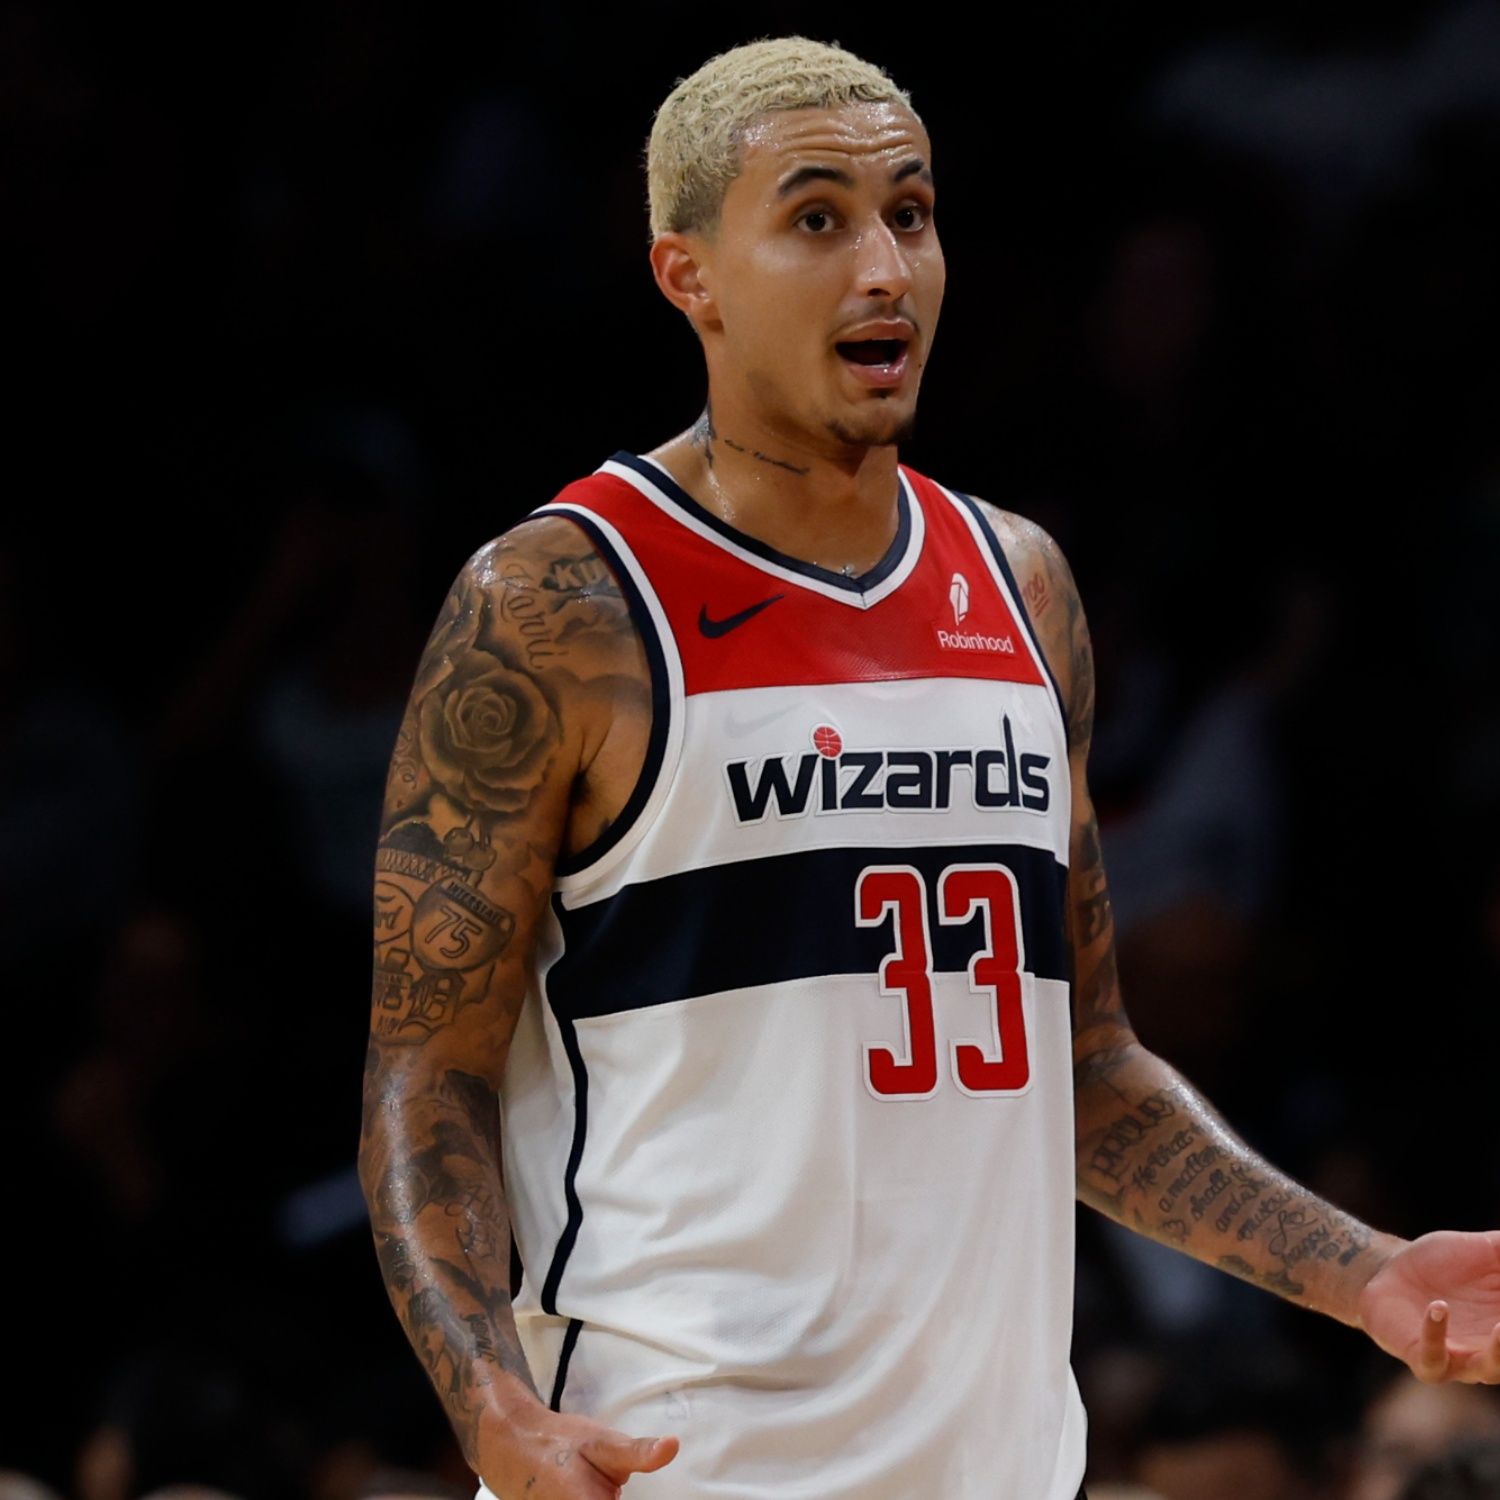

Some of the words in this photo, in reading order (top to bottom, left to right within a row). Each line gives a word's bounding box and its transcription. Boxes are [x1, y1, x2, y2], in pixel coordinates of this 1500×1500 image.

[937, 630, 1015, 654] Robinhood
[725, 713, 1052, 824] wizards
[425, 906, 483, 959] 75
[855, 862, 1036, 1101] 33
